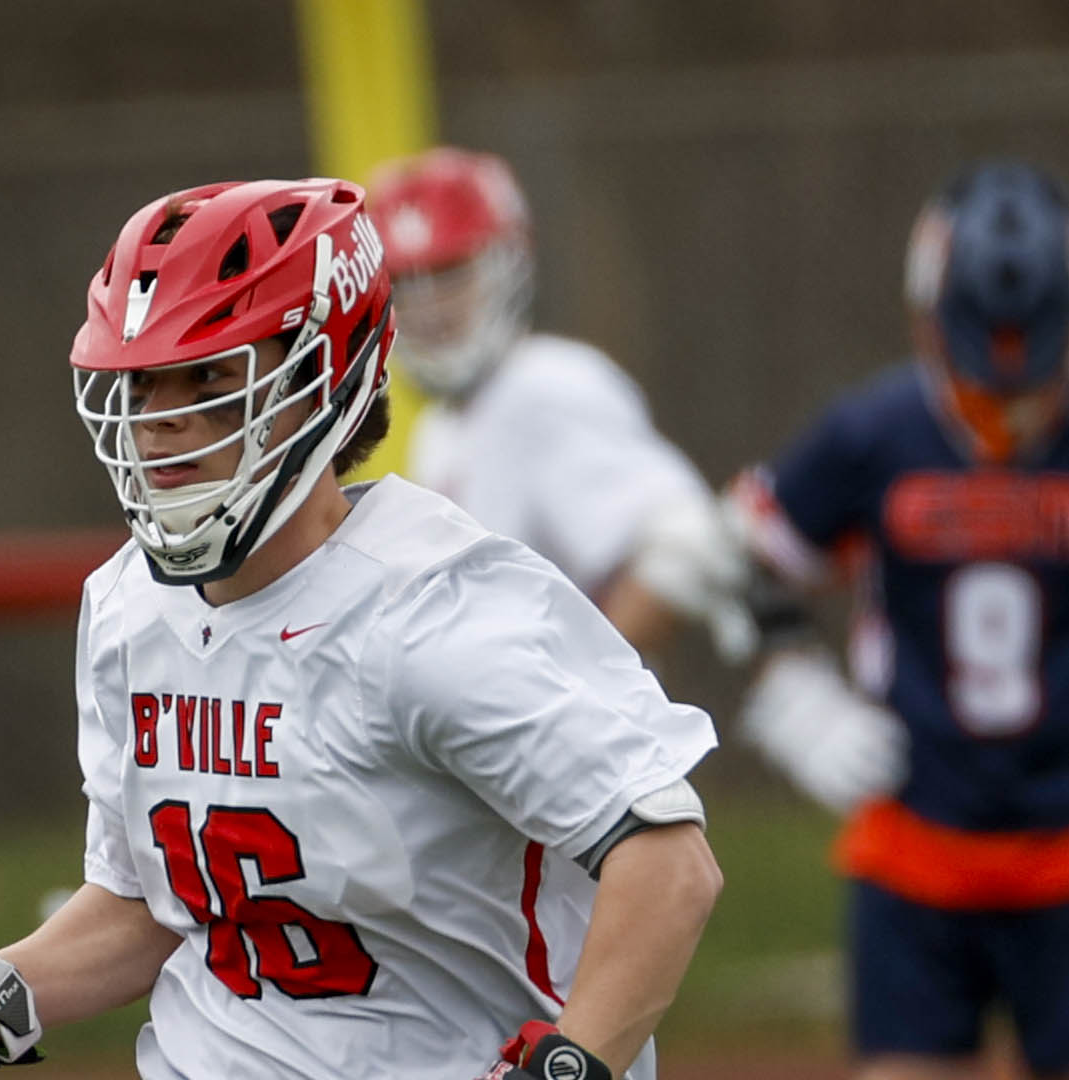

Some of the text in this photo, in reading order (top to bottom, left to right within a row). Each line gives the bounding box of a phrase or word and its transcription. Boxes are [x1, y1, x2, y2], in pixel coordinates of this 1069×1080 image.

[132, 692, 283, 779] B'VILLE
[943, 562, 1044, 737] 9
[148, 798, 379, 1000] 16
